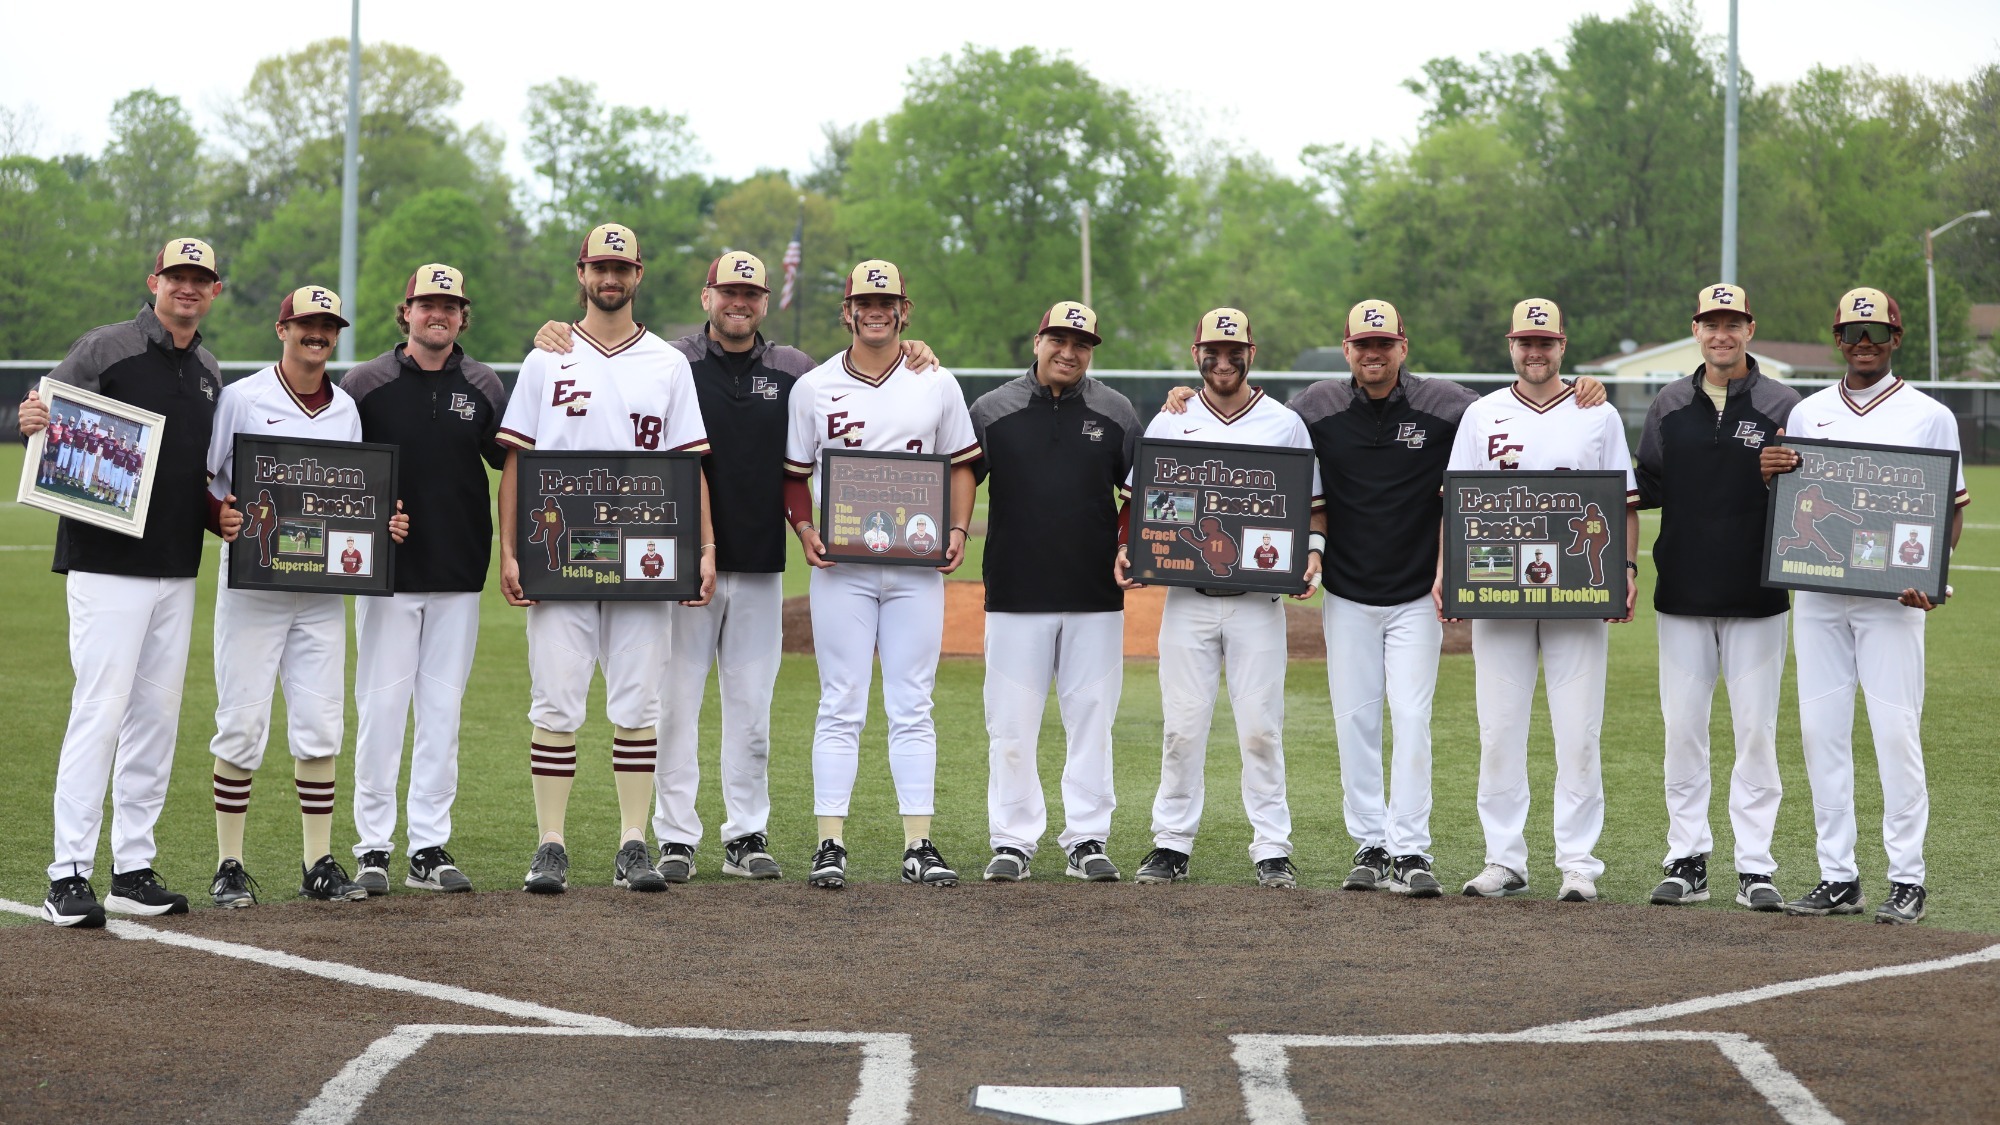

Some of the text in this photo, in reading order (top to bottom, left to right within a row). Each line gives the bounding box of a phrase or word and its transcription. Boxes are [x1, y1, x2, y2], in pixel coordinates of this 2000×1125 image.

[552, 379, 592, 417] EC
[630, 413, 662, 450] 18
[827, 411, 866, 447] EC
[255, 456, 366, 490] Earlham
[833, 463, 940, 486] Earlham
[1154, 457, 1277, 491] Earlham
[1800, 452, 1926, 490] Earlham
[539, 469, 665, 496] Earlham
[839, 484, 929, 506] Baseball
[1458, 485, 1584, 514] Earlham
[259, 506, 269, 520] 7
[834, 503, 853, 514] The
[1204, 490, 1287, 519] Baseball
[1800, 499, 1813, 513] 42
[834, 514, 861, 525] Show
[895, 506, 906, 526] 3
[834, 524, 861, 536] Goes
[1141, 527, 1177, 542] Crack
[1586, 520, 1601, 534] 35
[834, 535, 849, 546] On
[1151, 542, 1170, 555] the
[1210, 539, 1223, 553] 11
[271, 557, 325, 574] Superstar
[1155, 555, 1195, 571] Tomb
[562, 566, 621, 584] Hells Bells
[1458, 587, 1610, 604] No Sleep Till Brooklyn
